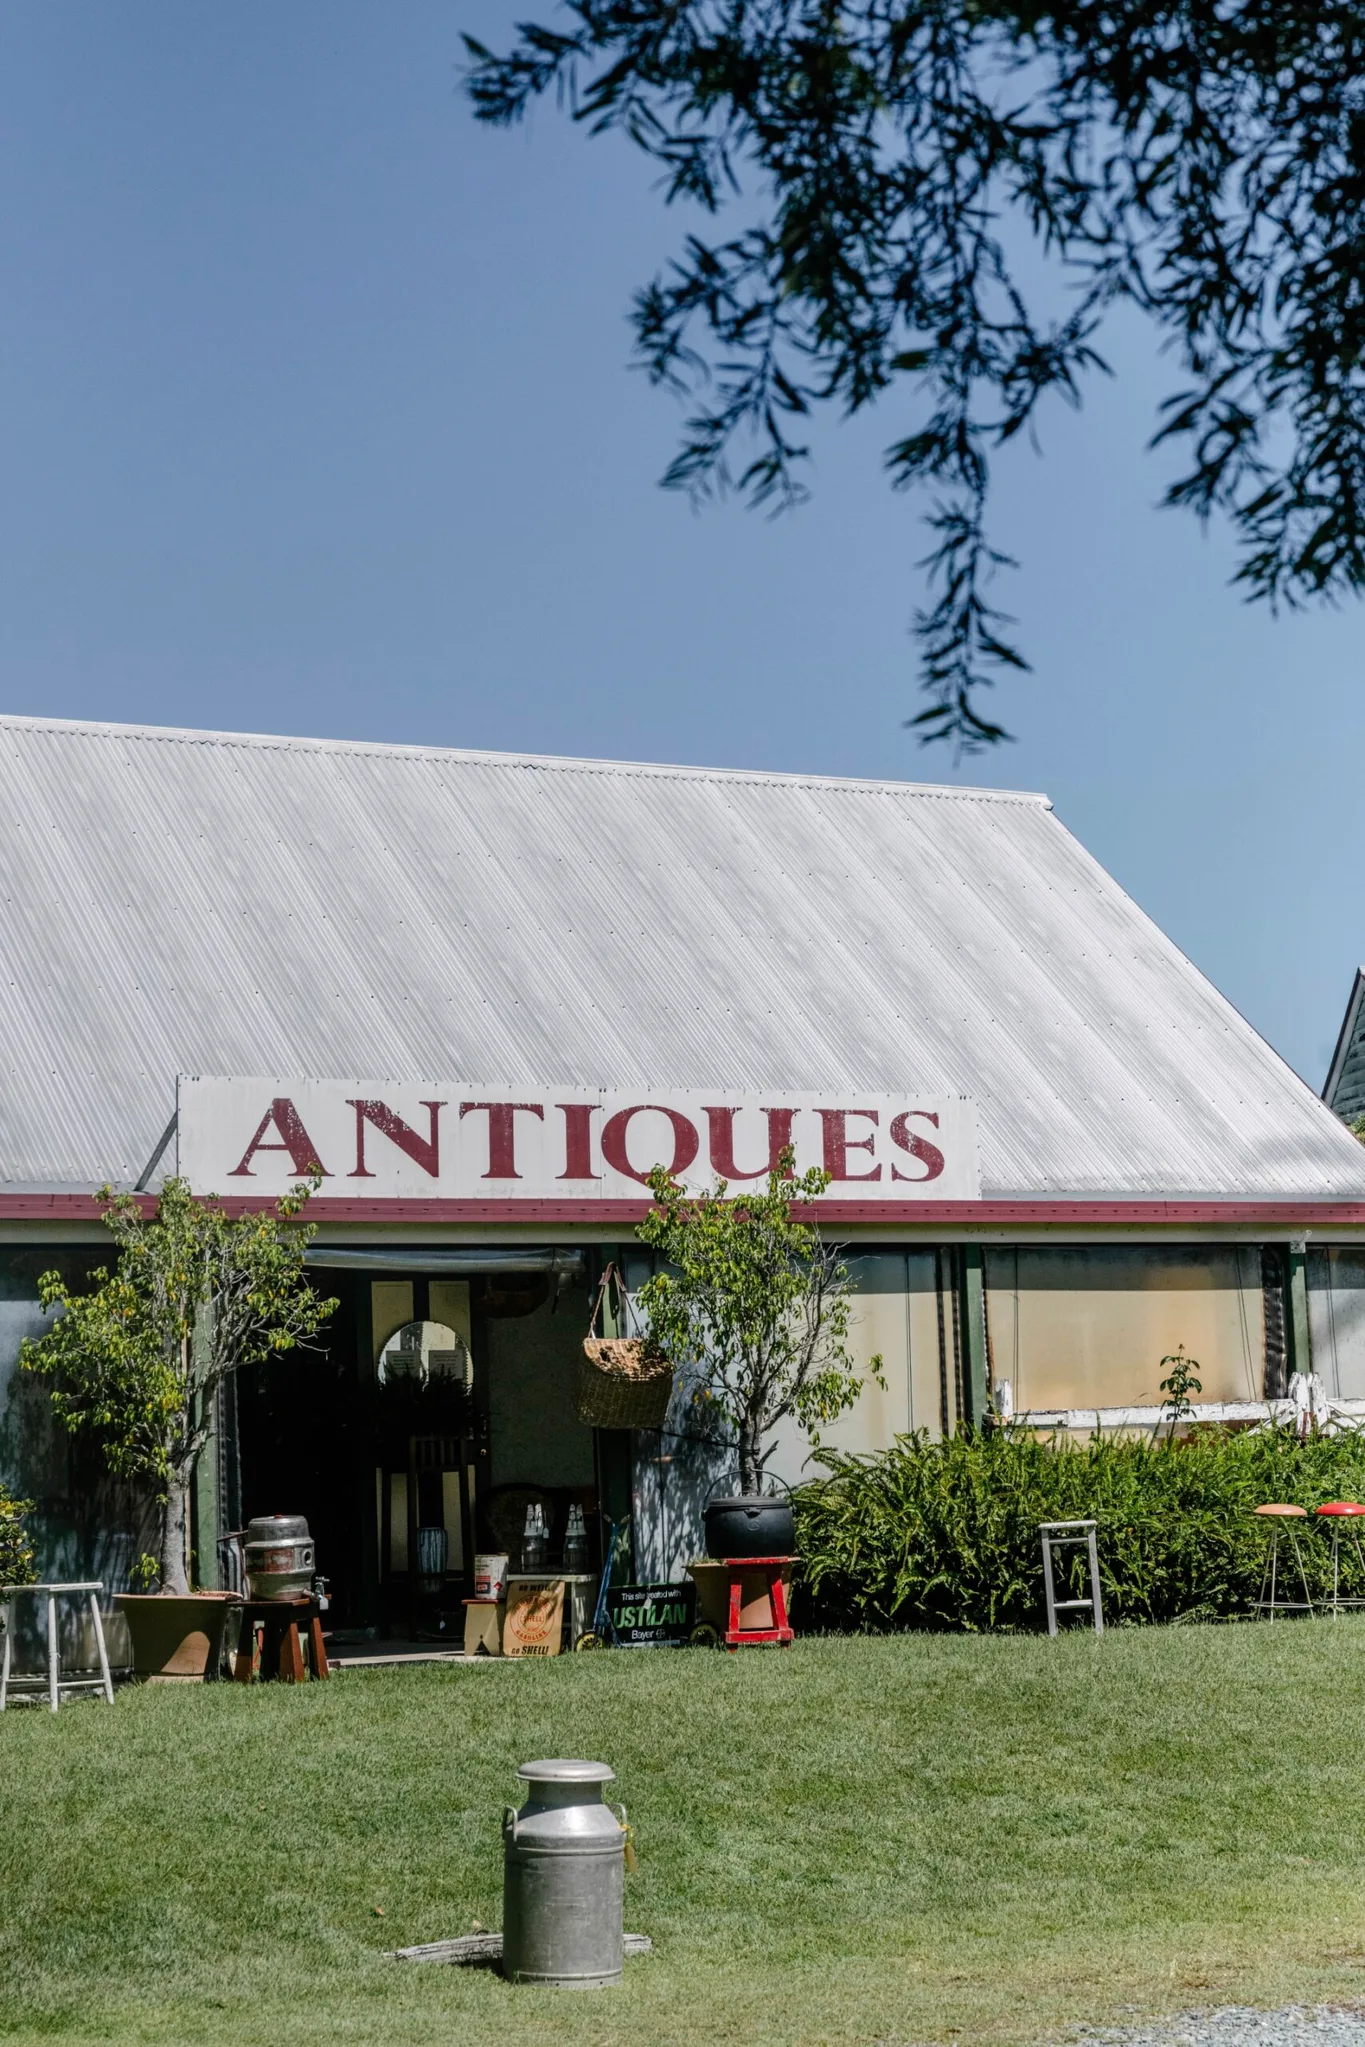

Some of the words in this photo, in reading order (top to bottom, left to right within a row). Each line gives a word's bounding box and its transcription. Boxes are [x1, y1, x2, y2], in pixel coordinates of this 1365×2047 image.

[227, 1097, 945, 1187] ANTIQUES
[621, 1592, 634, 1601] This
[635, 1592, 645, 1600] site
[668, 1589, 681, 1597] with
[523, 1615, 542, 1623] SHELL
[612, 1603, 687, 1629] USTILAN
[516, 1630, 547, 1641] GASOLINE
[631, 1629, 654, 1641] Bayer
